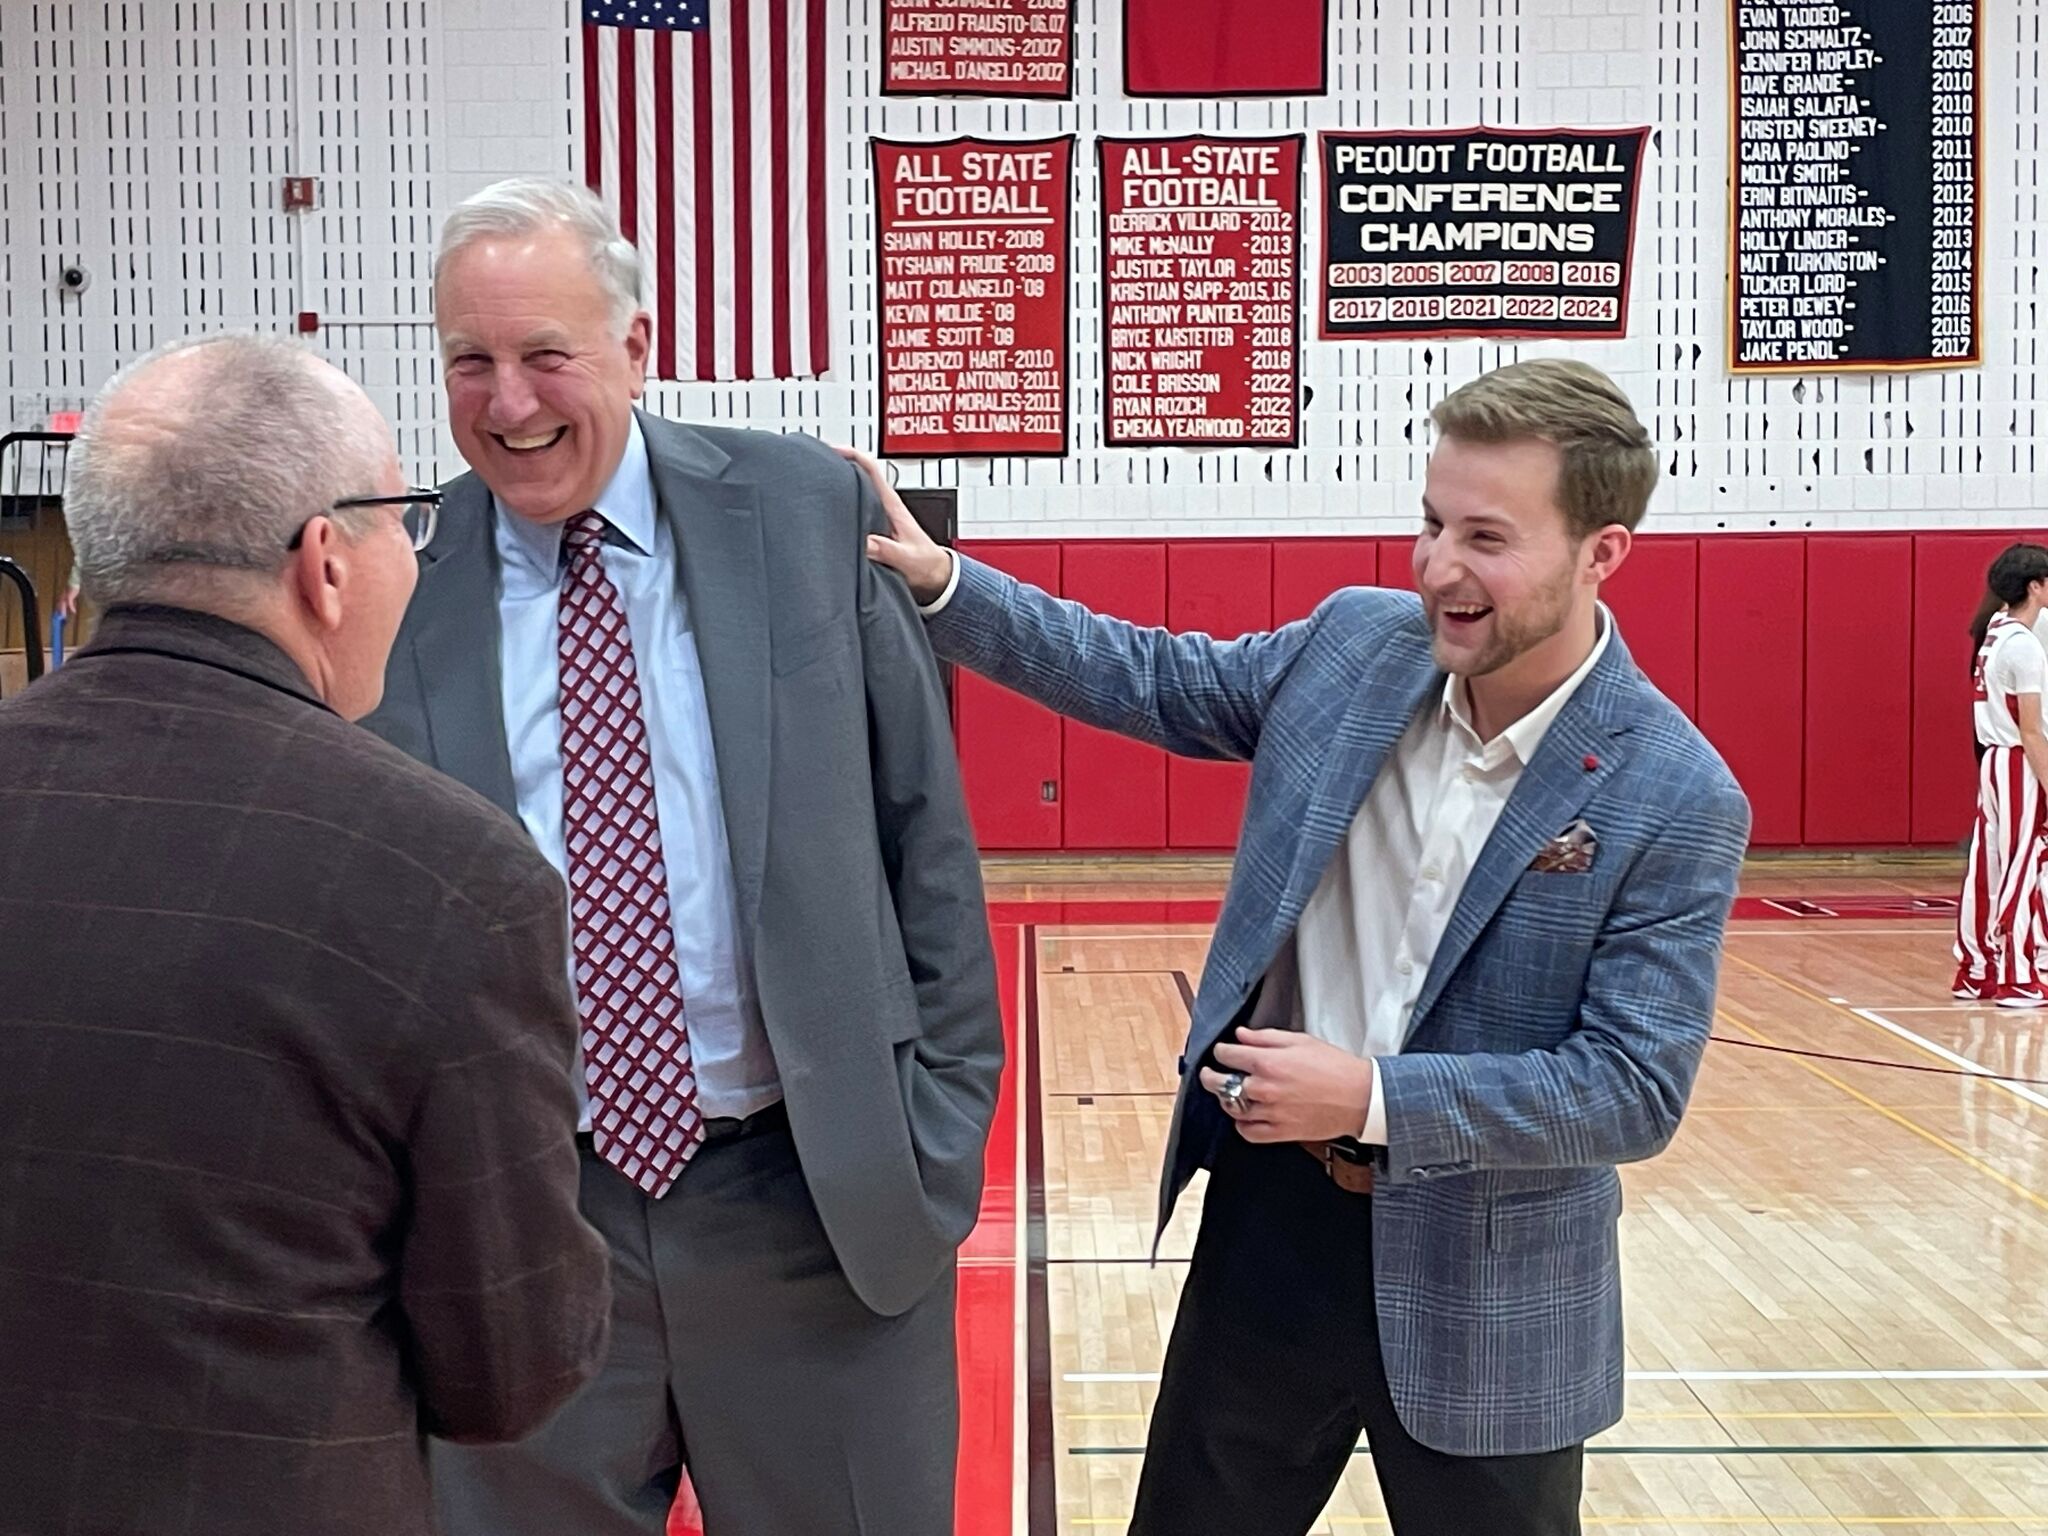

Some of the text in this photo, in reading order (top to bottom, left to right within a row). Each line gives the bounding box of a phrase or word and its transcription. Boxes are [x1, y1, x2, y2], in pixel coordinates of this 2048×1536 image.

[890, 13, 954, 32] ALFREDO
[1739, 8, 1777, 27] EVAN
[1932, 5, 1973, 24] 2006
[891, 37, 1062, 57] AUSTIN SIMMONS-2007
[1740, 31, 1779, 50] JOHN
[1932, 27, 1972, 48] 2007
[891, 60, 1066, 81] MICHAEL D'ANGELO-2007
[1741, 52, 1812, 73] JENNIFER
[1932, 50, 1973, 70] 2009
[1741, 76, 1779, 94] DAVE
[1932, 72, 1973, 92] 2010
[1741, 97, 1789, 117] ISAIAH
[1932, 94, 1973, 114] 2010
[1741, 120, 1804, 140] KRISTEN
[1932, 117, 1973, 136] 2010
[1336, 143, 1624, 175] PEQUOT FOOTBALL
[1741, 142, 1781, 162] CARA
[1932, 140, 1973, 159] 2011
[895, 152, 1052, 183] ALL STATE
[1741, 165, 1788, 184] MOLLY
[1932, 162, 1973, 182] 2011
[896, 186, 1049, 216] FOOTBALL
[1124, 178, 1277, 206] FOOTBALL
[1339, 183, 1621, 213] CONFERENCE
[1741, 187, 1775, 207] ERIN
[1932, 185, 1974, 204] 2012
[1109, 214, 1172, 232] DERRICK
[1741, 209, 1811, 229] ANTHONY
[1932, 207, 1973, 226] 2012
[884, 232, 932, 251] SHAWN
[1110, 237, 1145, 255] MIKE
[1361, 222, 1594, 253] CHAMPIONS
[1741, 231, 1788, 251] HOLLY
[1932, 229, 1973, 249] 2013
[885, 256, 953, 275] TYSHAWN
[1110, 259, 1173, 278] JUSTICE
[1178, 259, 1235, 278] TAYLOR
[1741, 253, 1779, 273] MATT
[1932, 251, 1972, 271] 2014
[1334, 264, 1615, 284] 2003 2006 2007 2008 2016
[1741, 275, 1800, 295] TUCKER
[1931, 273, 1971, 293] 2015
[886, 281, 923, 299] MATT
[1111, 282, 1178, 301] KRISTIAN
[886, 304, 929, 323] KEVIN
[1112, 305, 1181, 324] ANTHONY
[1334, 298, 1612, 319] 2017 2018 2021 2022 2024
[1741, 297, 1789, 318] PETER
[1931, 295, 1971, 315] 2016
[887, 329, 931, 348] JAMIE
[1111, 328, 1151, 348] BRYCE
[1155, 328, 1234, 347] KARSTETTER
[1741, 320, 1796, 339] TAYLOR
[1931, 317, 1971, 336] 2016
[887, 349, 1054, 370] LAURENZO HART-2010
[1740, 341, 1785, 361] JAKE
[1931, 338, 1971, 357] 2017
[1112, 352, 1147, 370] NICK
[1151, 351, 1203, 370] WRIGHT
[888, 371, 1060, 392] MICHAEL ANTONIO-2011
[1112, 374, 1152, 393] COLE
[1158, 373, 1220, 393] BRISSON
[887, 393, 1061, 414] ANTHONY MORALES-2011
[1113, 397, 1151, 416] RYAN
[1155, 397, 1207, 416] ROZICH
[888, 414, 1061, 435] MICHAEL SULLIVAN-2011
[1113, 419, 1164, 438] EMEKA
